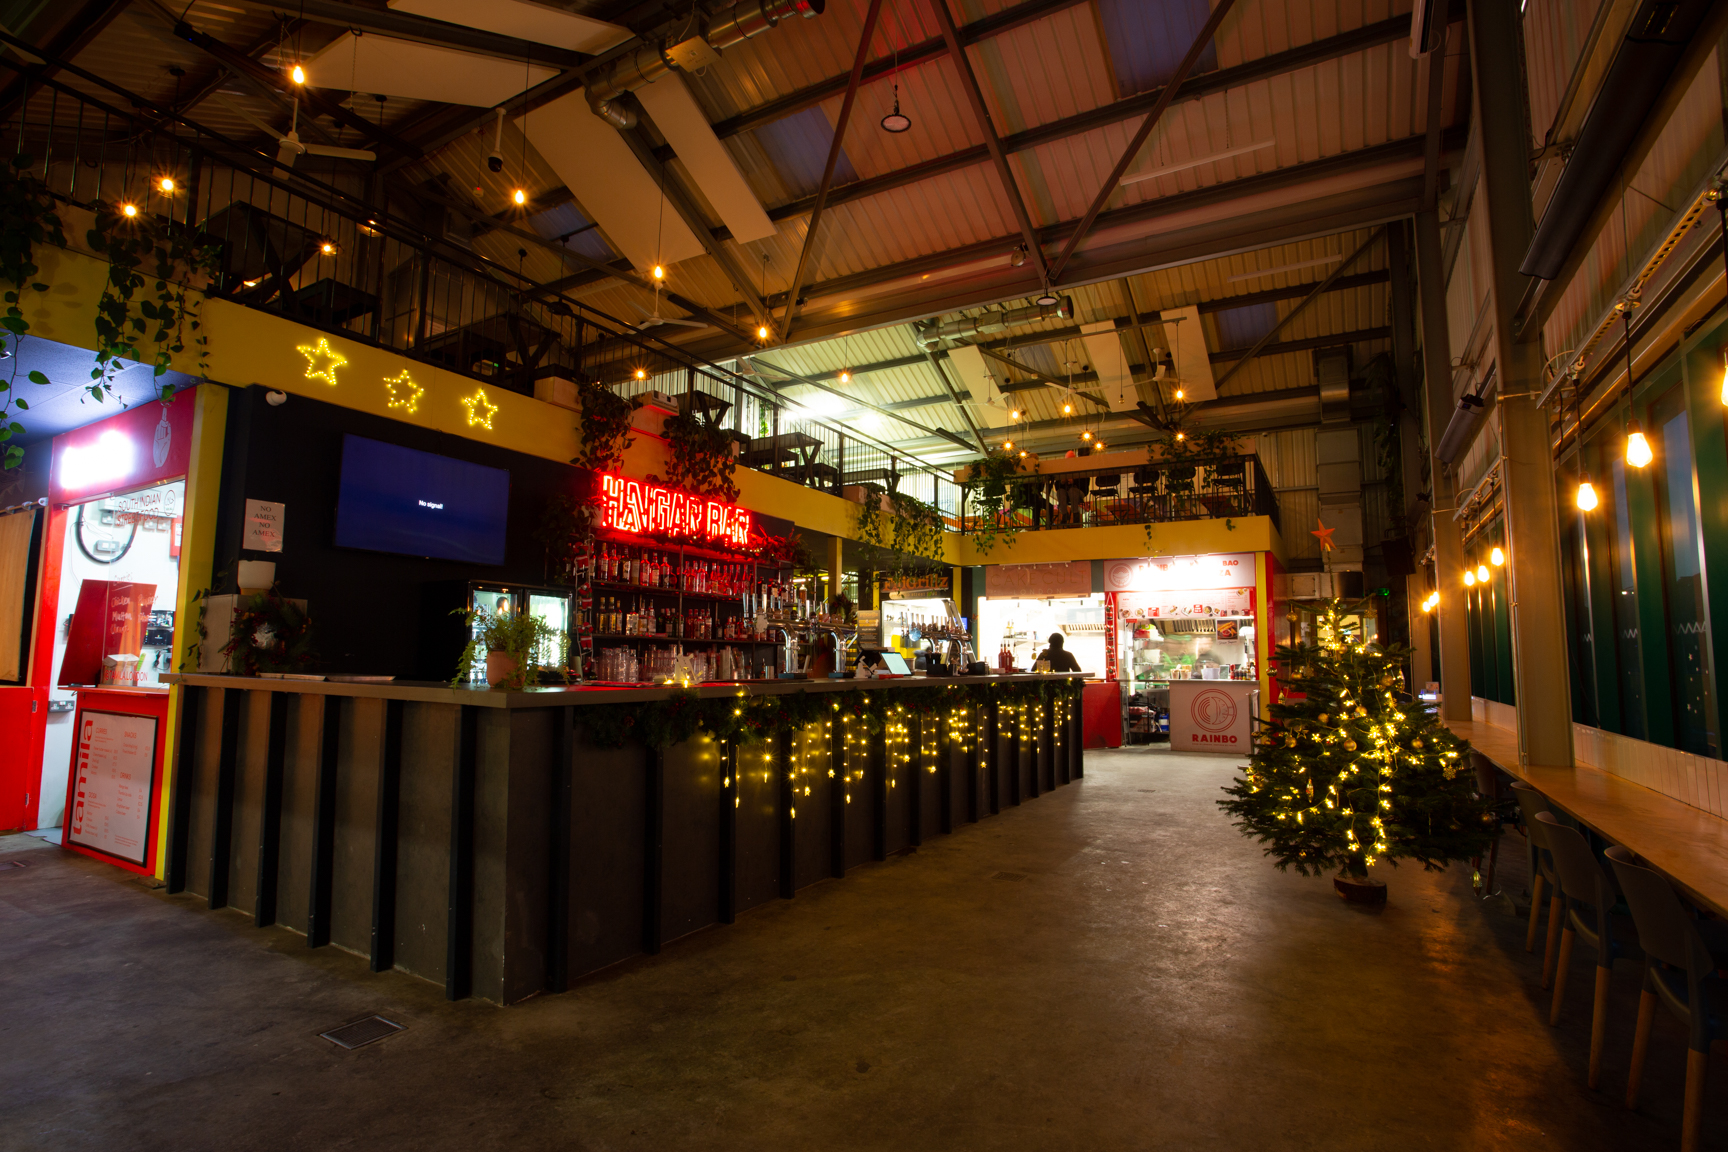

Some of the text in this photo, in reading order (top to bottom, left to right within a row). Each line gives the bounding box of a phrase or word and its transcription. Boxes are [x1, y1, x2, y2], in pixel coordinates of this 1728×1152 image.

[118, 492, 162, 512] SOUTH INDIAN
[602, 475, 750, 546] HANGAR BAR
[116, 507, 159, 526] STREET FOOD
[254, 513, 277, 521] AMEX
[990, 570, 1086, 586] CAKE CULT
[1192, 734, 1238, 743] RAINBO
[72, 720, 94, 836] tamila
